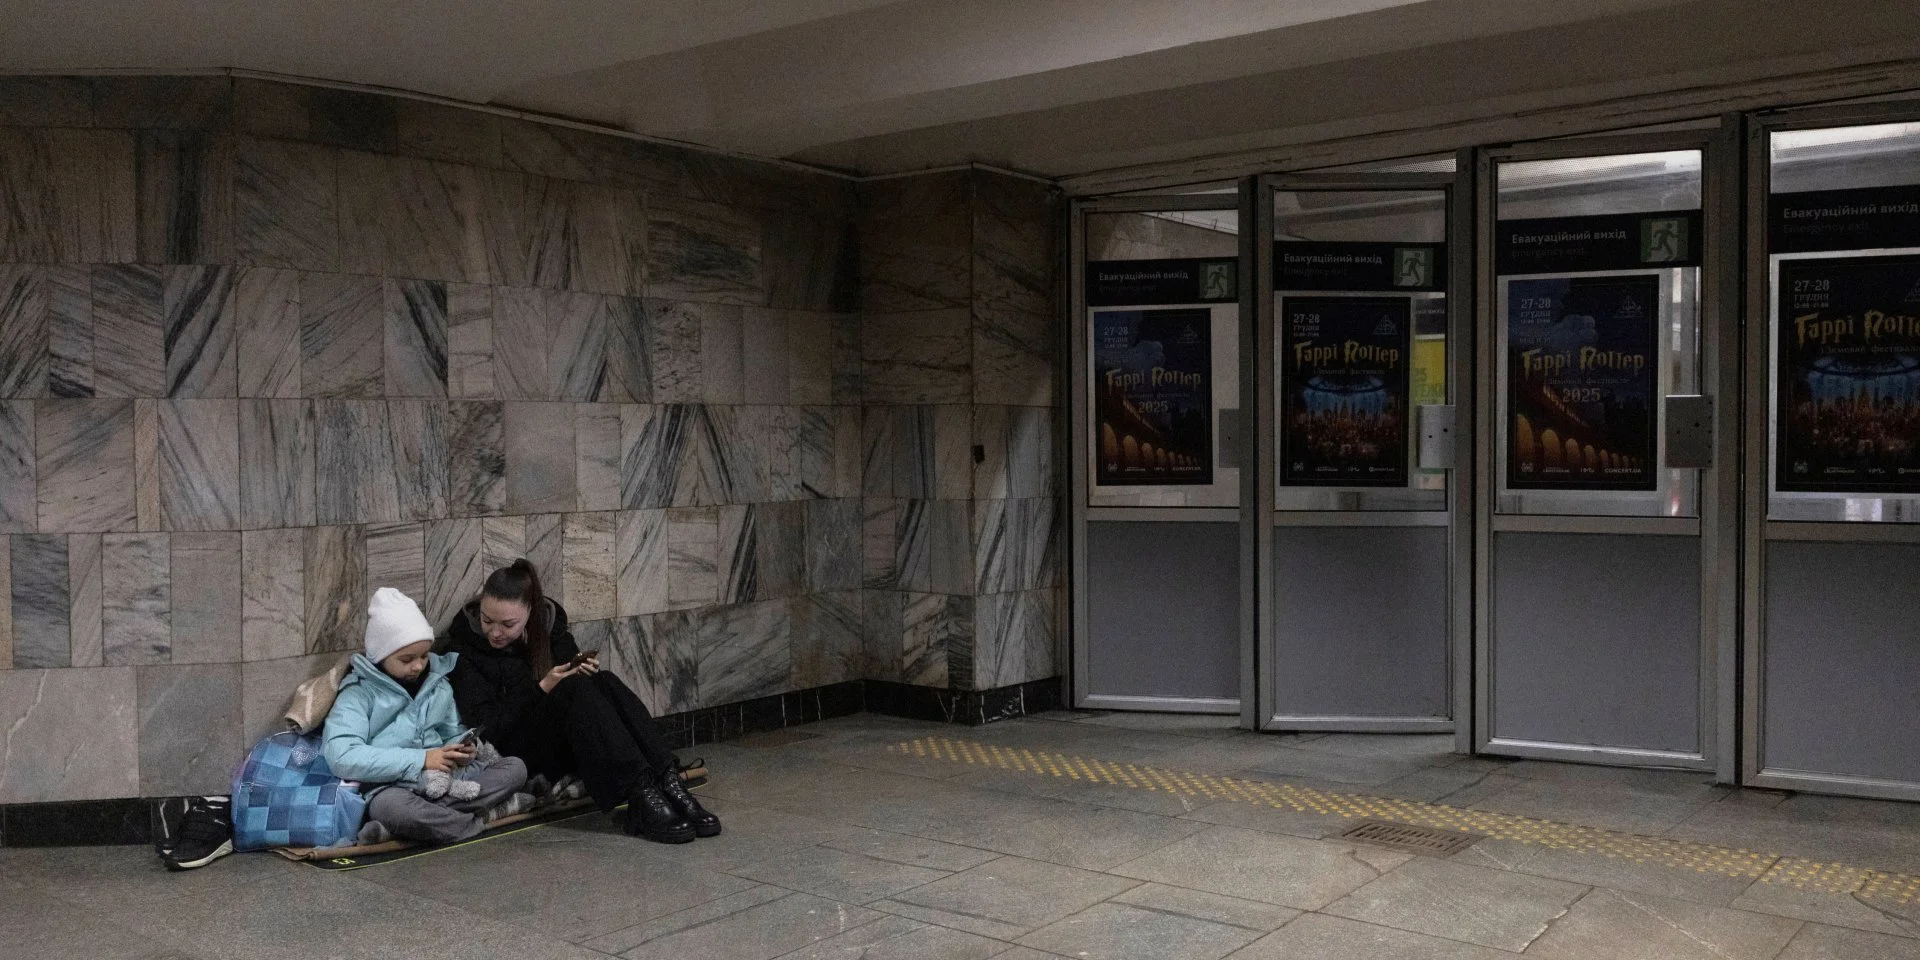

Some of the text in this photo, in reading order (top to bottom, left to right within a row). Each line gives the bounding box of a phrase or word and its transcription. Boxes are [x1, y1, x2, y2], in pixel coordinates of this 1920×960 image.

[1783, 201, 1919, 220] Евакуаційний вихід
[1511, 229, 1627, 245] Евакуаційний вихід
[1283, 253, 1383, 266] Евакуаційний вихід
[1098, 269, 1189, 283] Евакуаційний вихід
[1794, 279, 1830, 292] 27-28
[1520, 297, 1551, 309] 27-28
[1293, 313, 1320, 324] 27-28
[1103, 326, 1129, 336] 27-28
[1794, 311, 1854, 350] Гаррі
[1293, 338, 1399, 371] Гаррі Поттер
[1521, 345, 1645, 381] Гаррі Поттер
[1562, 387, 1601, 403] 2025
[1138, 400, 1169, 414] 2025
